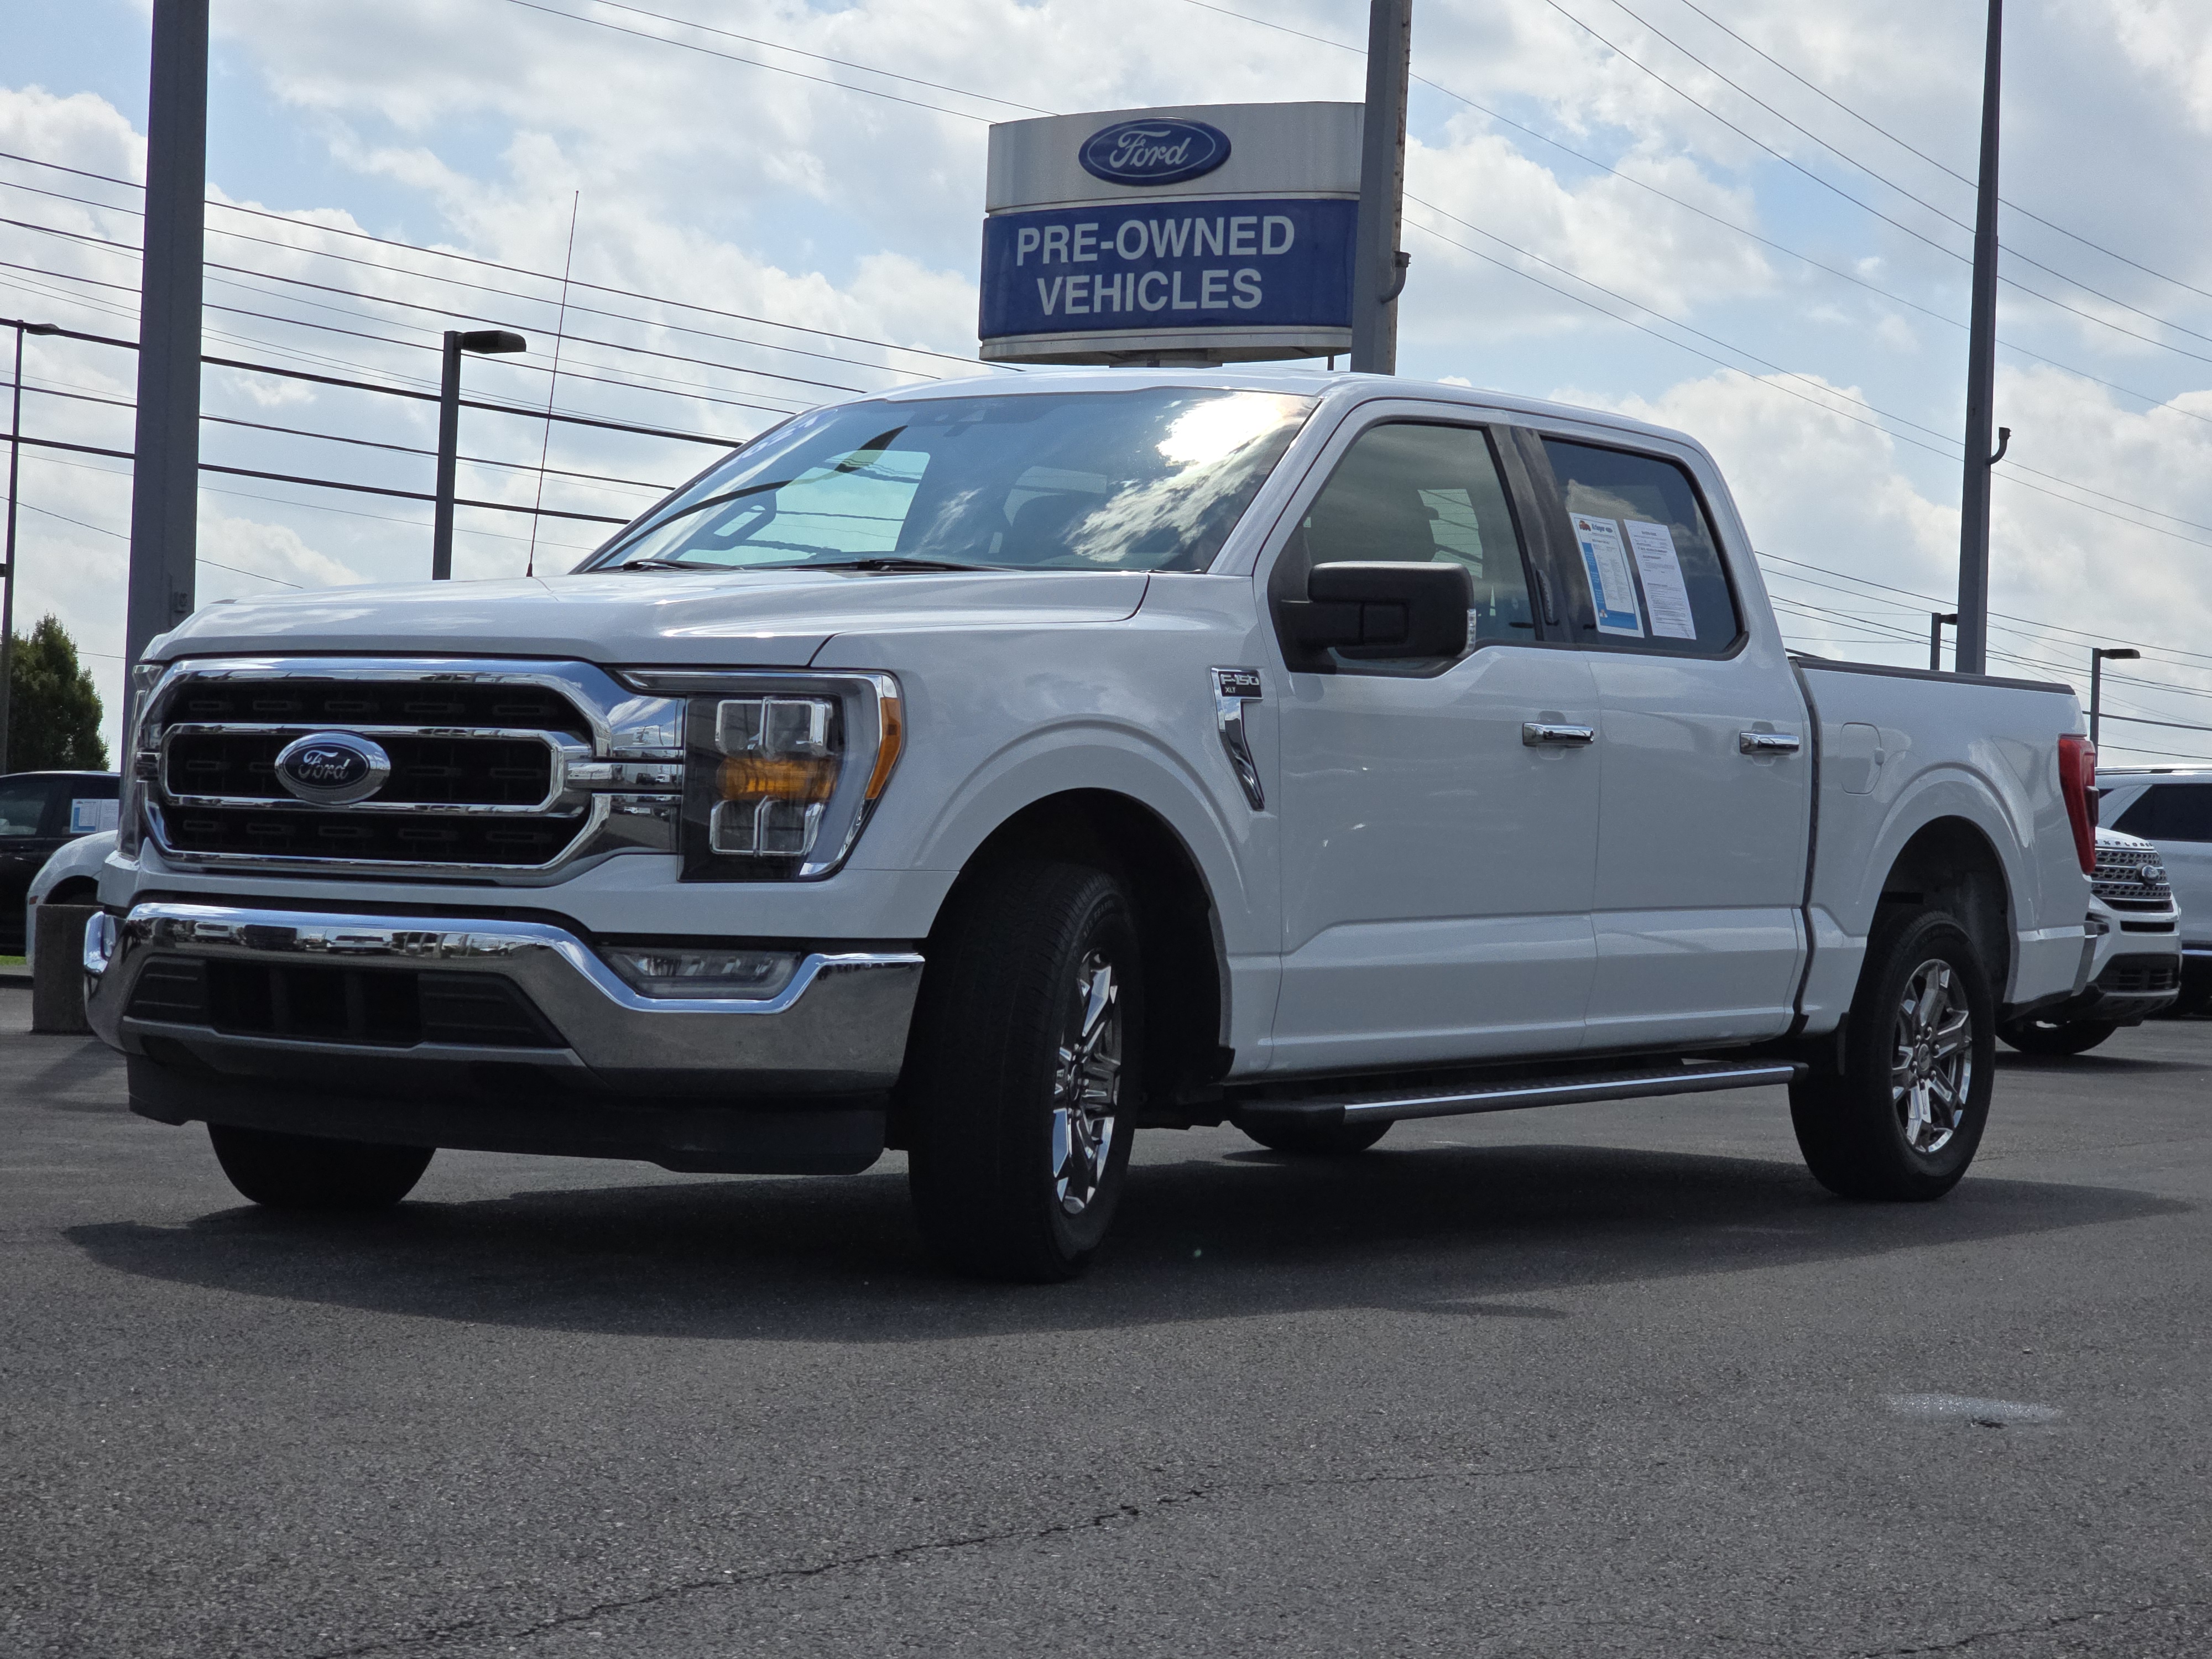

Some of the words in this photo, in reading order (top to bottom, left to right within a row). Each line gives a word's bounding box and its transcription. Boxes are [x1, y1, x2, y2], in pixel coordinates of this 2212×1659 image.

[1109, 131, 1192, 168] Ford
[1016, 216, 1295, 266] PRE-OWNED
[1037, 268, 1262, 315] VEHICLES
[1220, 674, 1259, 686] F-150
[299, 750, 351, 779] Ford
